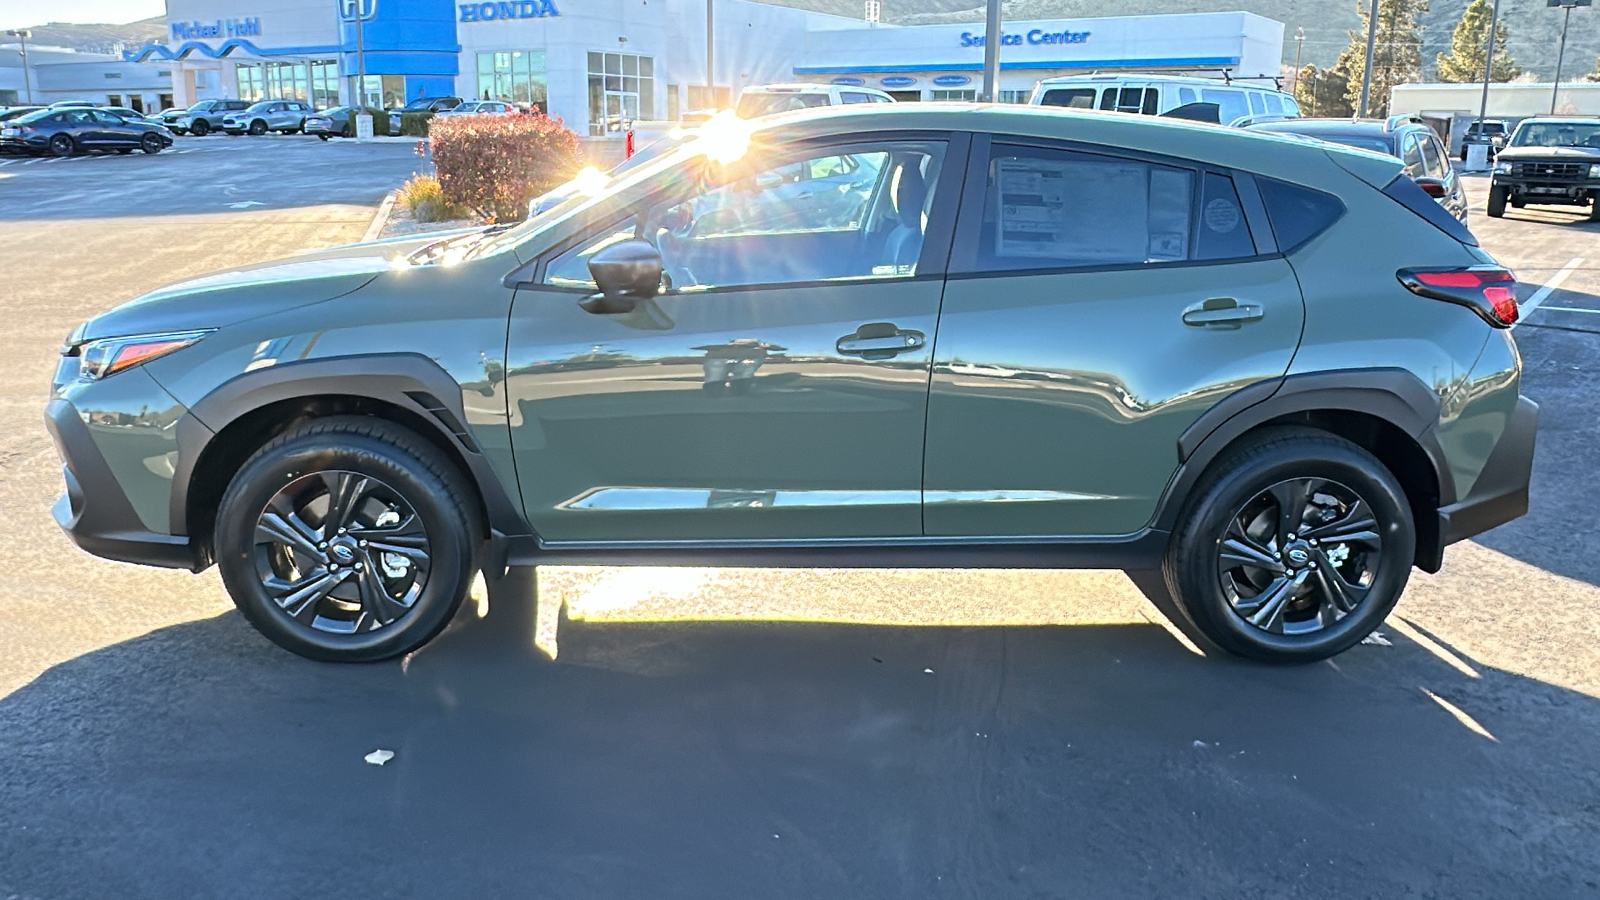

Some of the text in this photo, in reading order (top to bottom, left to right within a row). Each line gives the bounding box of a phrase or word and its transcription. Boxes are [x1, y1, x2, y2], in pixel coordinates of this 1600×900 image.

[459, 0, 560, 22] HONDA
[172, 20, 222, 39] Michael
[960, 29, 1091, 48] Serice Center
